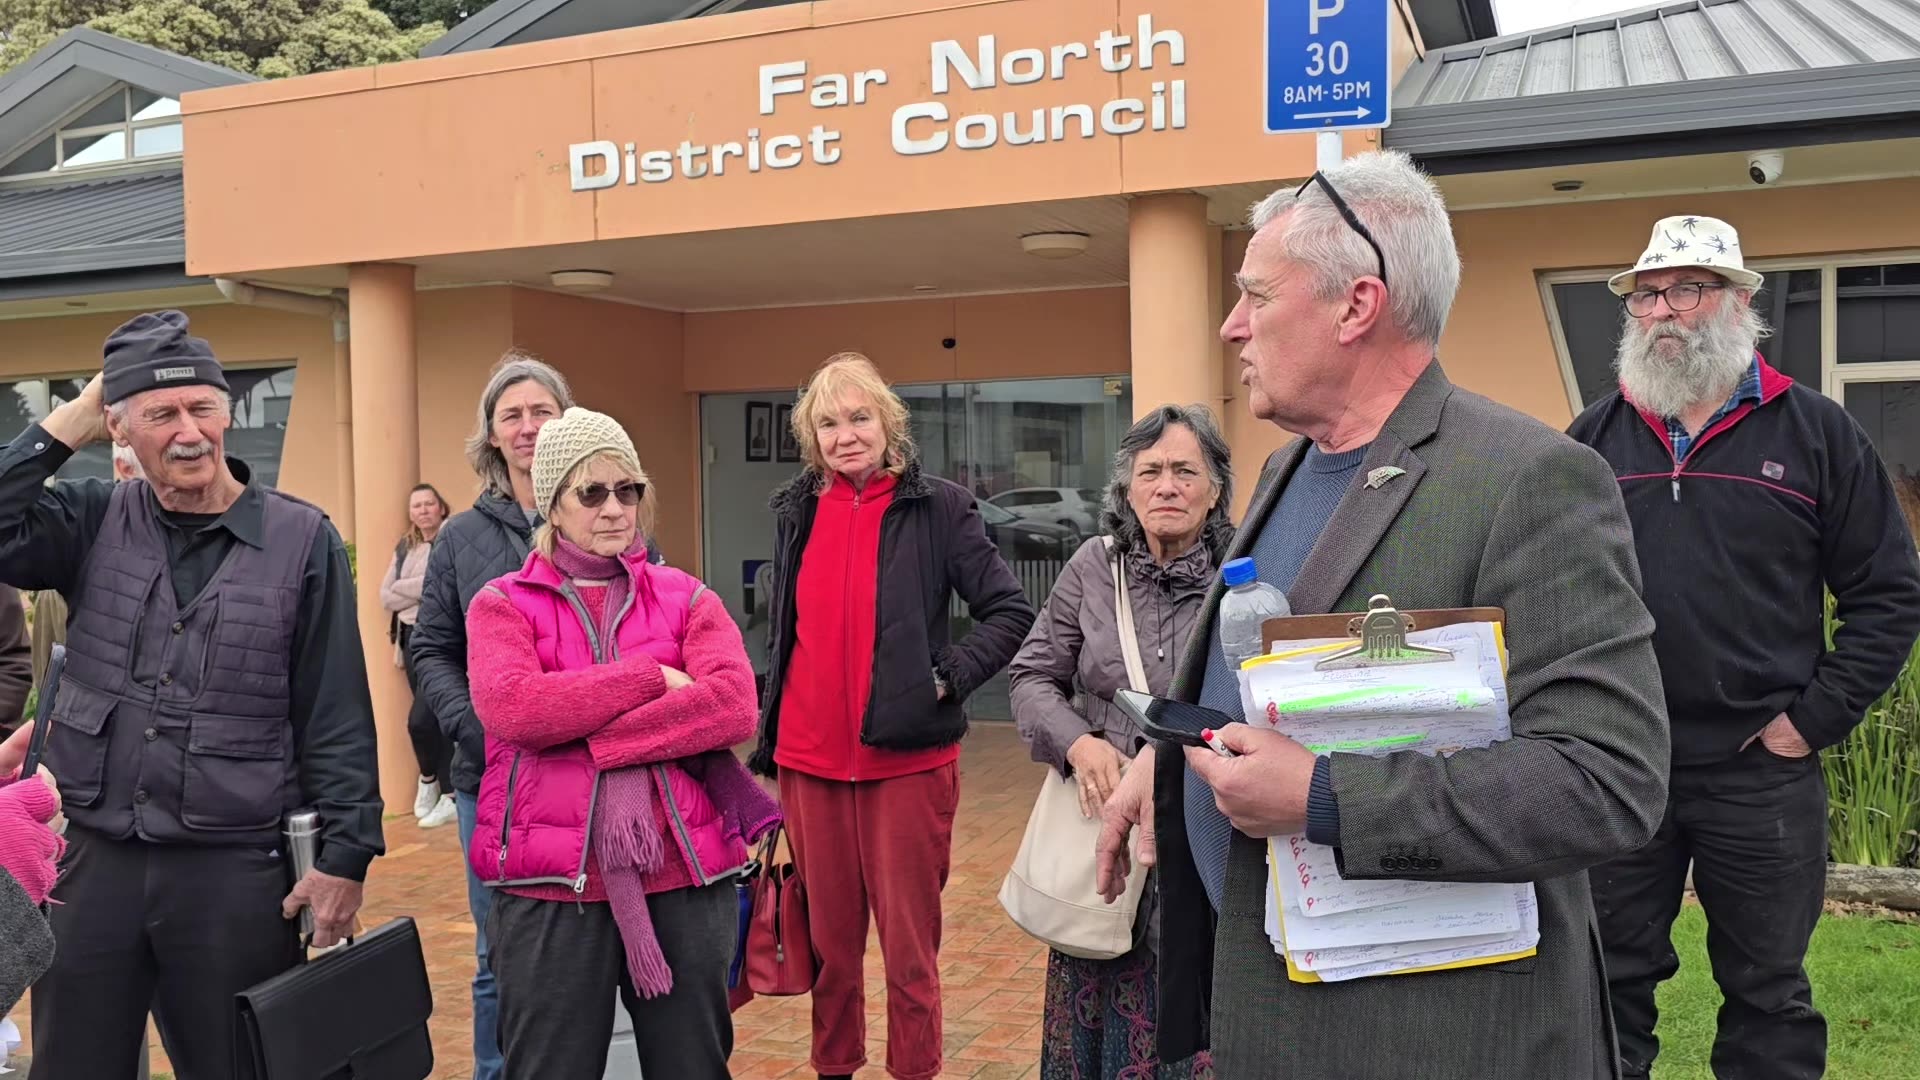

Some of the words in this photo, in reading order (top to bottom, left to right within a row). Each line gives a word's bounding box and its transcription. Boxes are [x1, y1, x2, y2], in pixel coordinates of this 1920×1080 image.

[1309, 0, 1345, 34] P
[759, 60, 887, 115] Far
[930, 14, 1186, 93] North
[1305, 40, 1349, 77] 30
[568, 124, 842, 190] District
[891, 79, 1188, 155] Council
